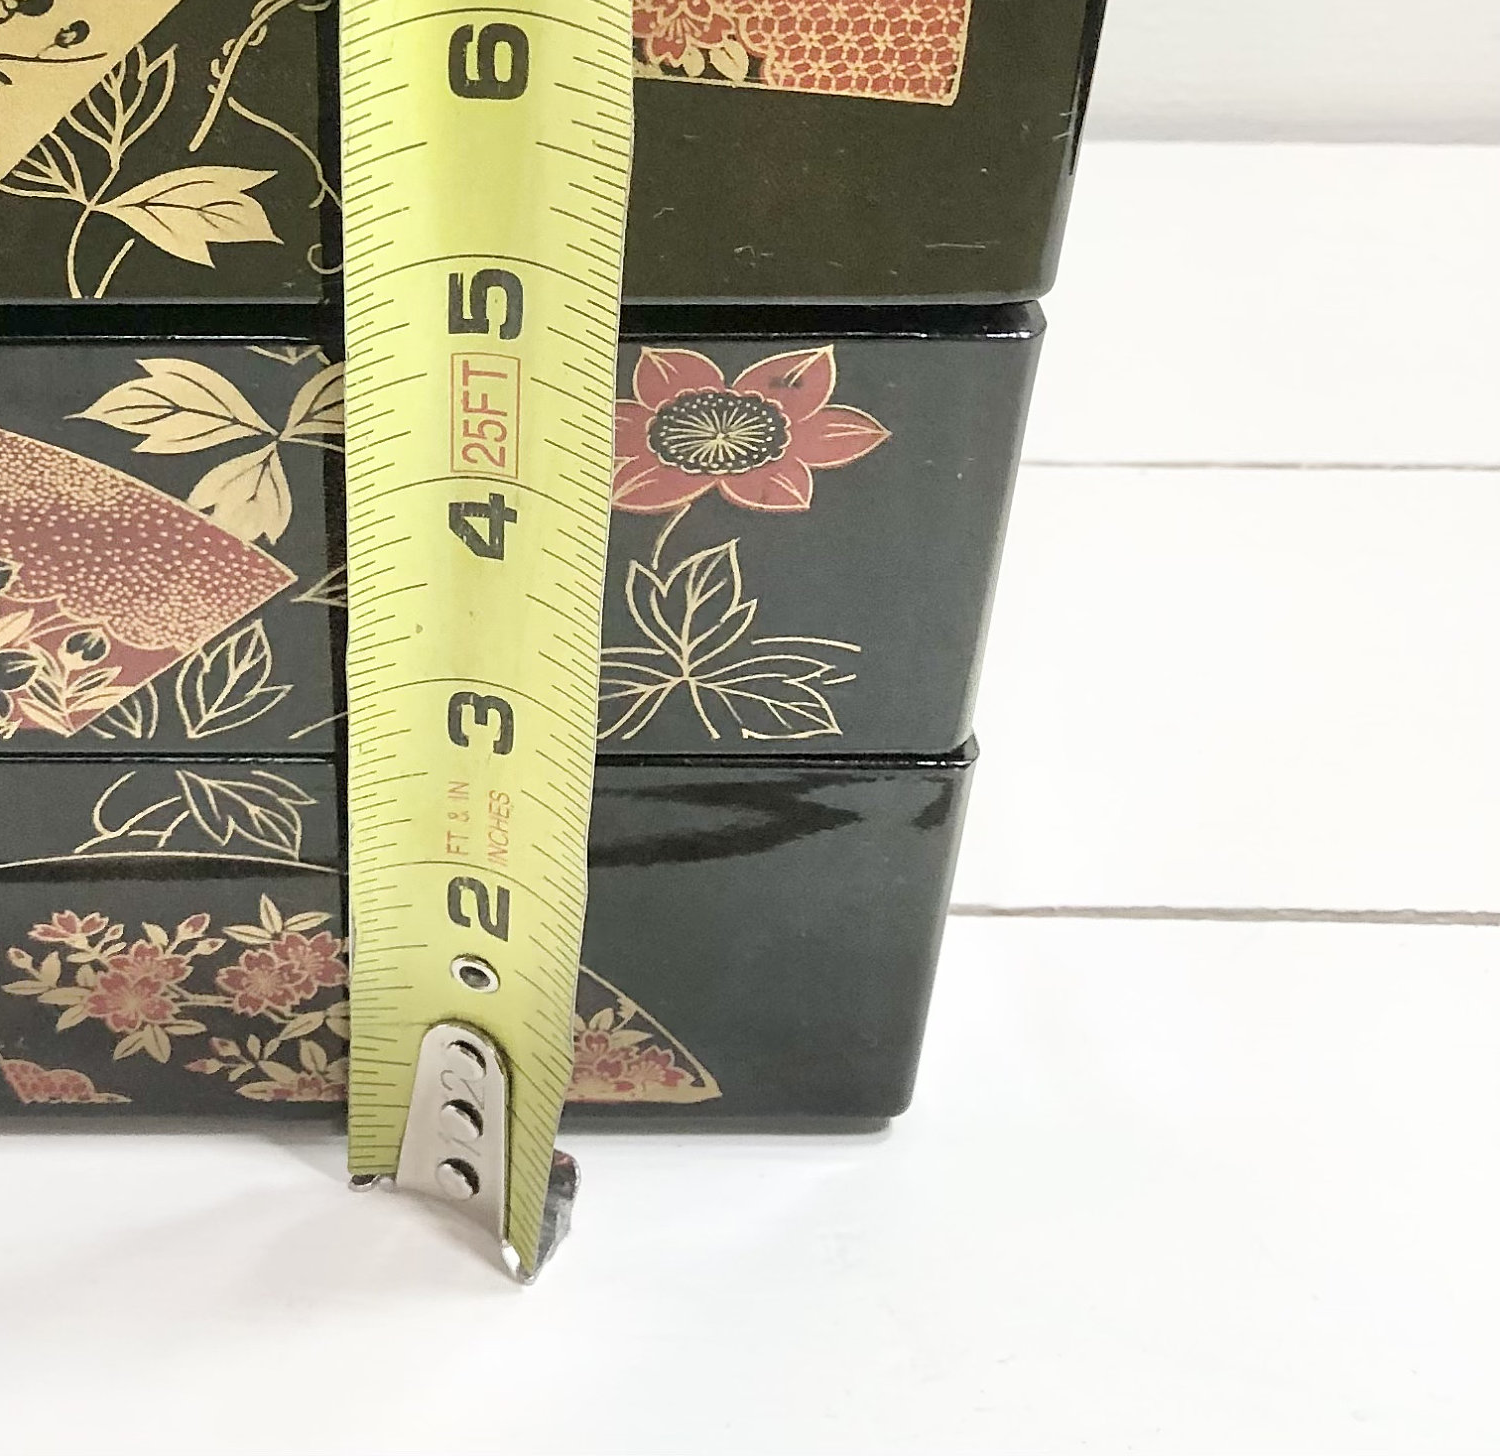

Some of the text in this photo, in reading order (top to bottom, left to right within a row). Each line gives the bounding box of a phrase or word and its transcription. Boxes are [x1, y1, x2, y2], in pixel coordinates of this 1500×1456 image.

[448, 22, 530, 101] 6
[448, 268, 524, 341] 5
[461, 359, 509, 469] 25FT
[448, 492, 518, 561] 4
[447, 691, 514, 756] 3
[447, 781, 470, 801] IN
[446, 830, 470, 856] FT
[486, 789, 511, 867] INCHES
[446, 875, 511, 943] 2
